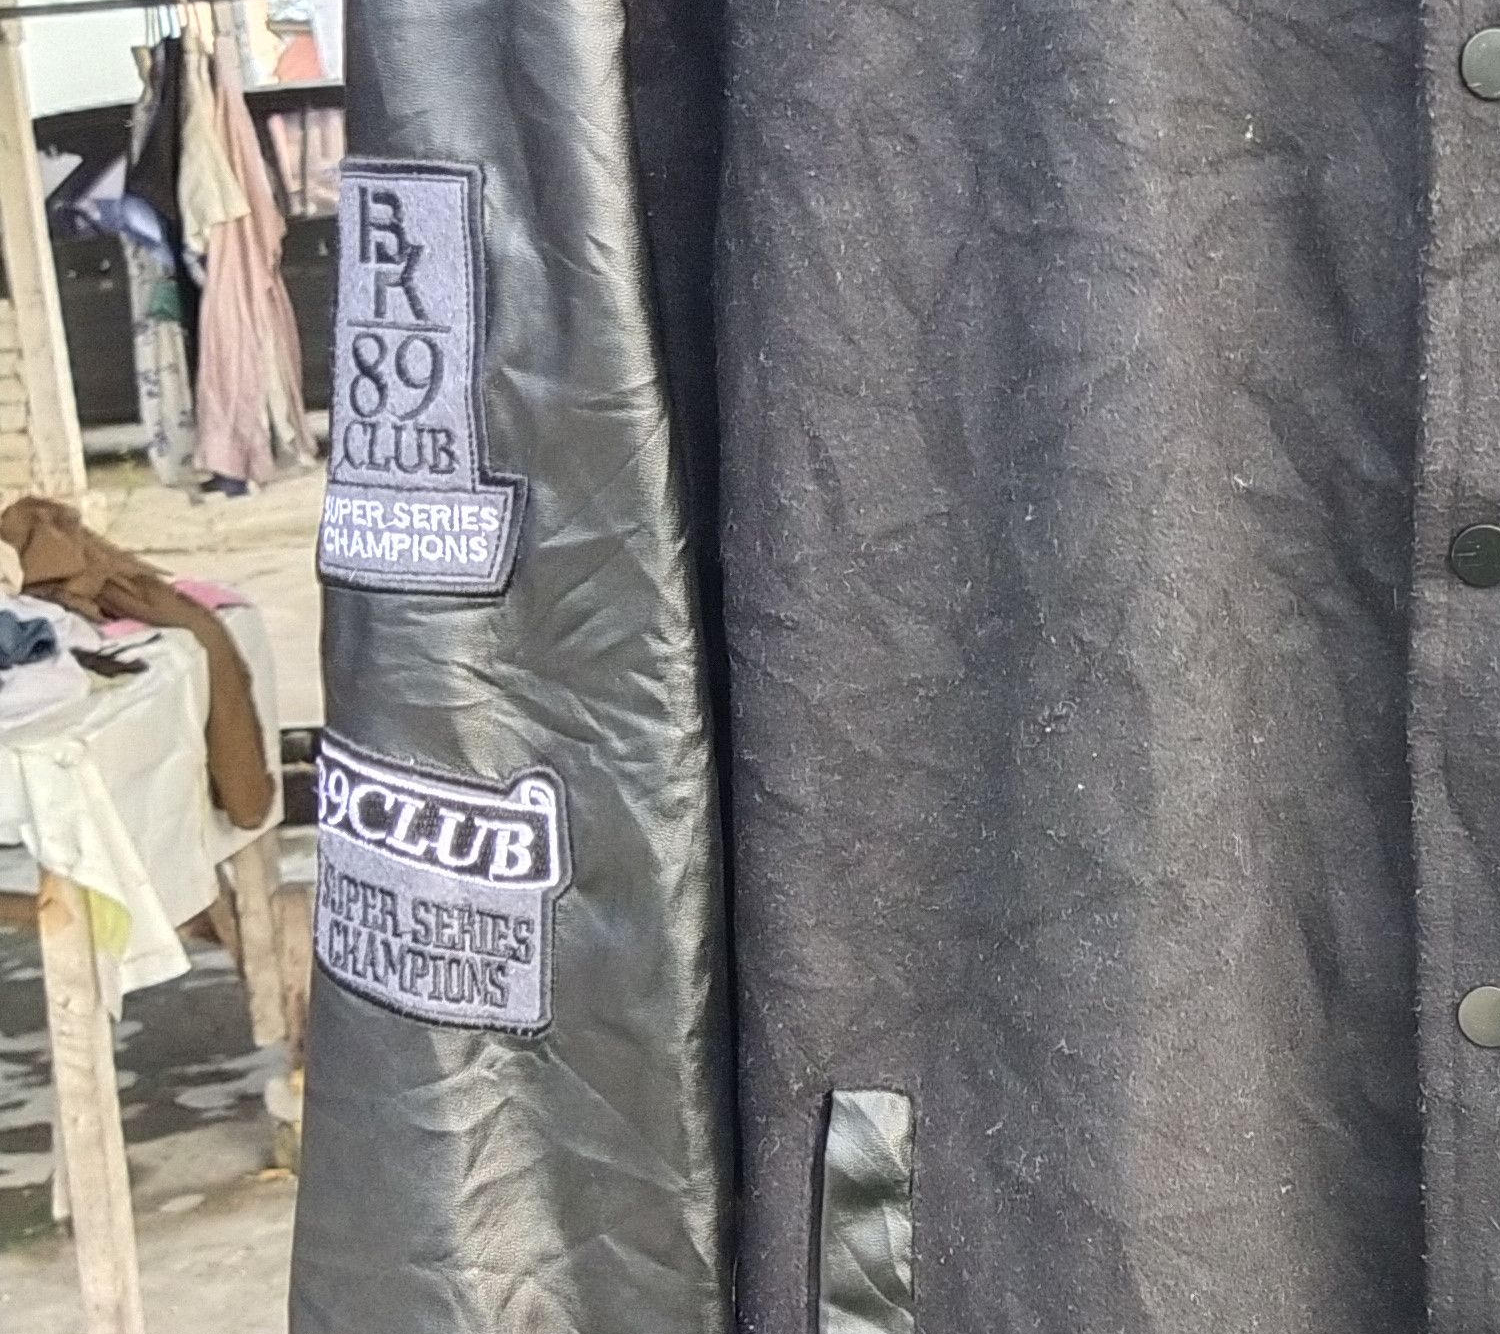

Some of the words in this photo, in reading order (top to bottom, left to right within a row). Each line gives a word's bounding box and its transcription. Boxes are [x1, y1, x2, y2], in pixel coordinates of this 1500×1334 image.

[349, 332, 444, 421] 89
[342, 419, 461, 474] CLUB
[323, 526, 488, 564] CHAMPIONS
[393, 501, 500, 532] SERIES
[411, 897, 535, 964] SERIES
[328, 918, 509, 1008] CHAMPIONS
